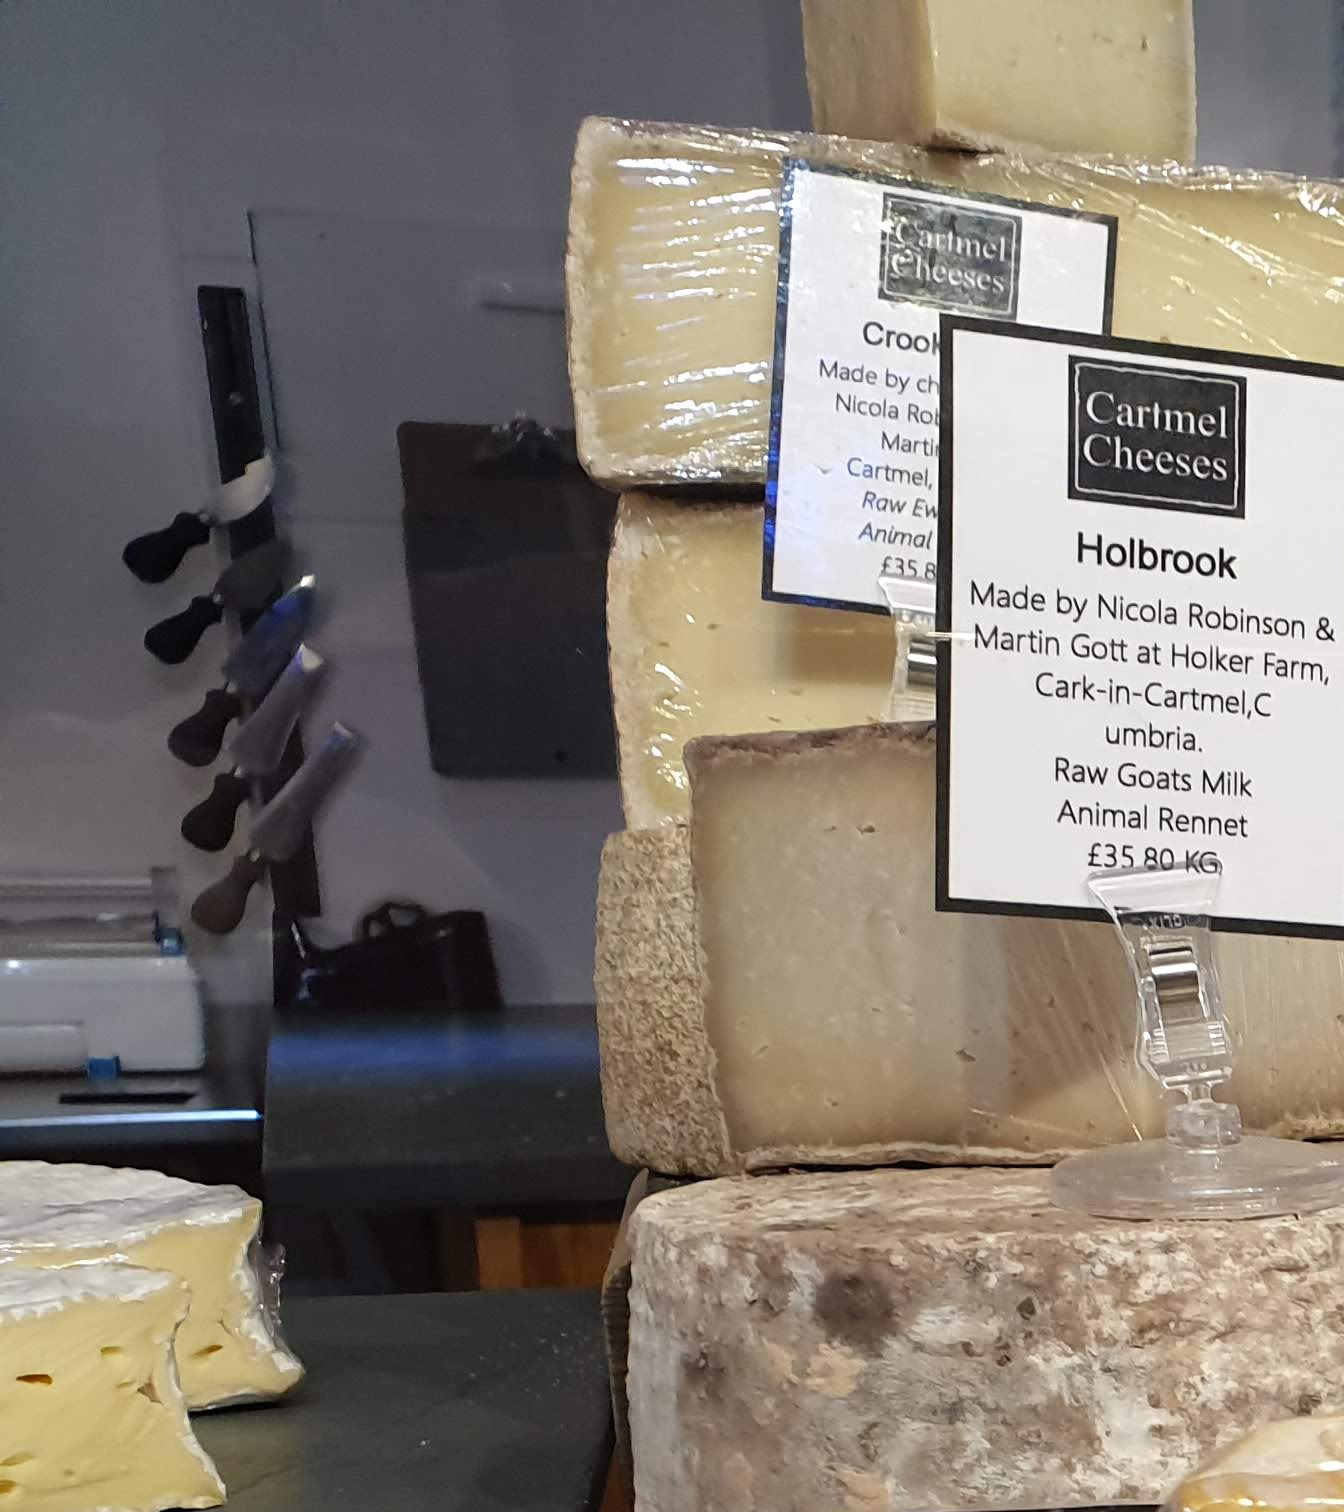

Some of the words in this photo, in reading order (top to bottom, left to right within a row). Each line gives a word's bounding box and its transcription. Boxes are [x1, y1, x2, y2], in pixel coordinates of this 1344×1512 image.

[1086, 391, 1229, 439] Cartmel
[1083, 434, 1229, 482] Cheeses
[1077, 531, 1237, 580] Holbrook
[971, 580, 1046, 612] Made
[1056, 588, 1088, 623] by
[1097, 593, 1178, 625] Nicola
[1188, 602, 1306, 640] Robinson
[1315, 616, 1336, 642] &
[974, 623, 1060, 657] Martin
[1070, 632, 1128, 663] Gott
[1136, 642, 1161, 666] at
[1171, 643, 1255, 675] Holker
[1263, 652, 1329, 686] Farm,
[1105, 722, 1203, 753] umbria.
[1055, 756, 1109, 786] Raw
[1117, 762, 1192, 792] Goats
[1202, 769, 1252, 798] Milk
[1057, 799, 1148, 830] Animal
[1159, 806, 1249, 838] Rennet
[1185, 849, 1219, 874] KG
